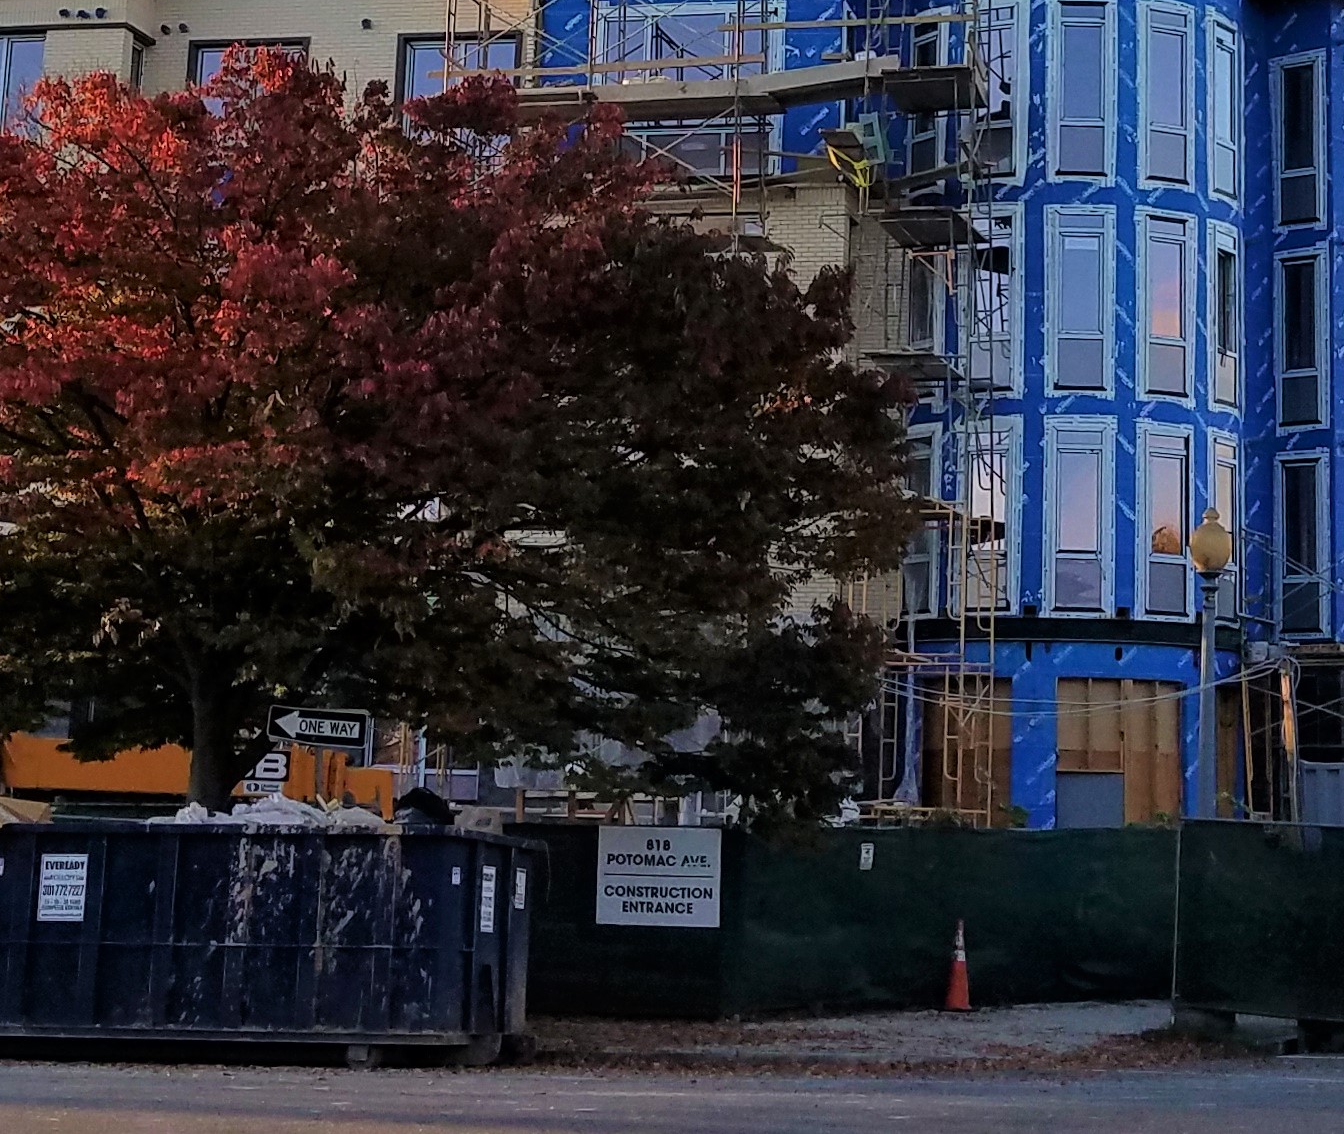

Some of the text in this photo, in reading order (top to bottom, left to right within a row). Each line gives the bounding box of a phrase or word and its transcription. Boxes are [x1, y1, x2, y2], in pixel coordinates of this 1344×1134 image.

[299, 719, 357, 737] ONE WAY
[645, 838, 671, 852] 818
[606, 853, 711, 868] POTOMAC AVE.
[603, 884, 713, 900] CONSTRUCTION
[621, 900, 694, 915] ENTRANCE
